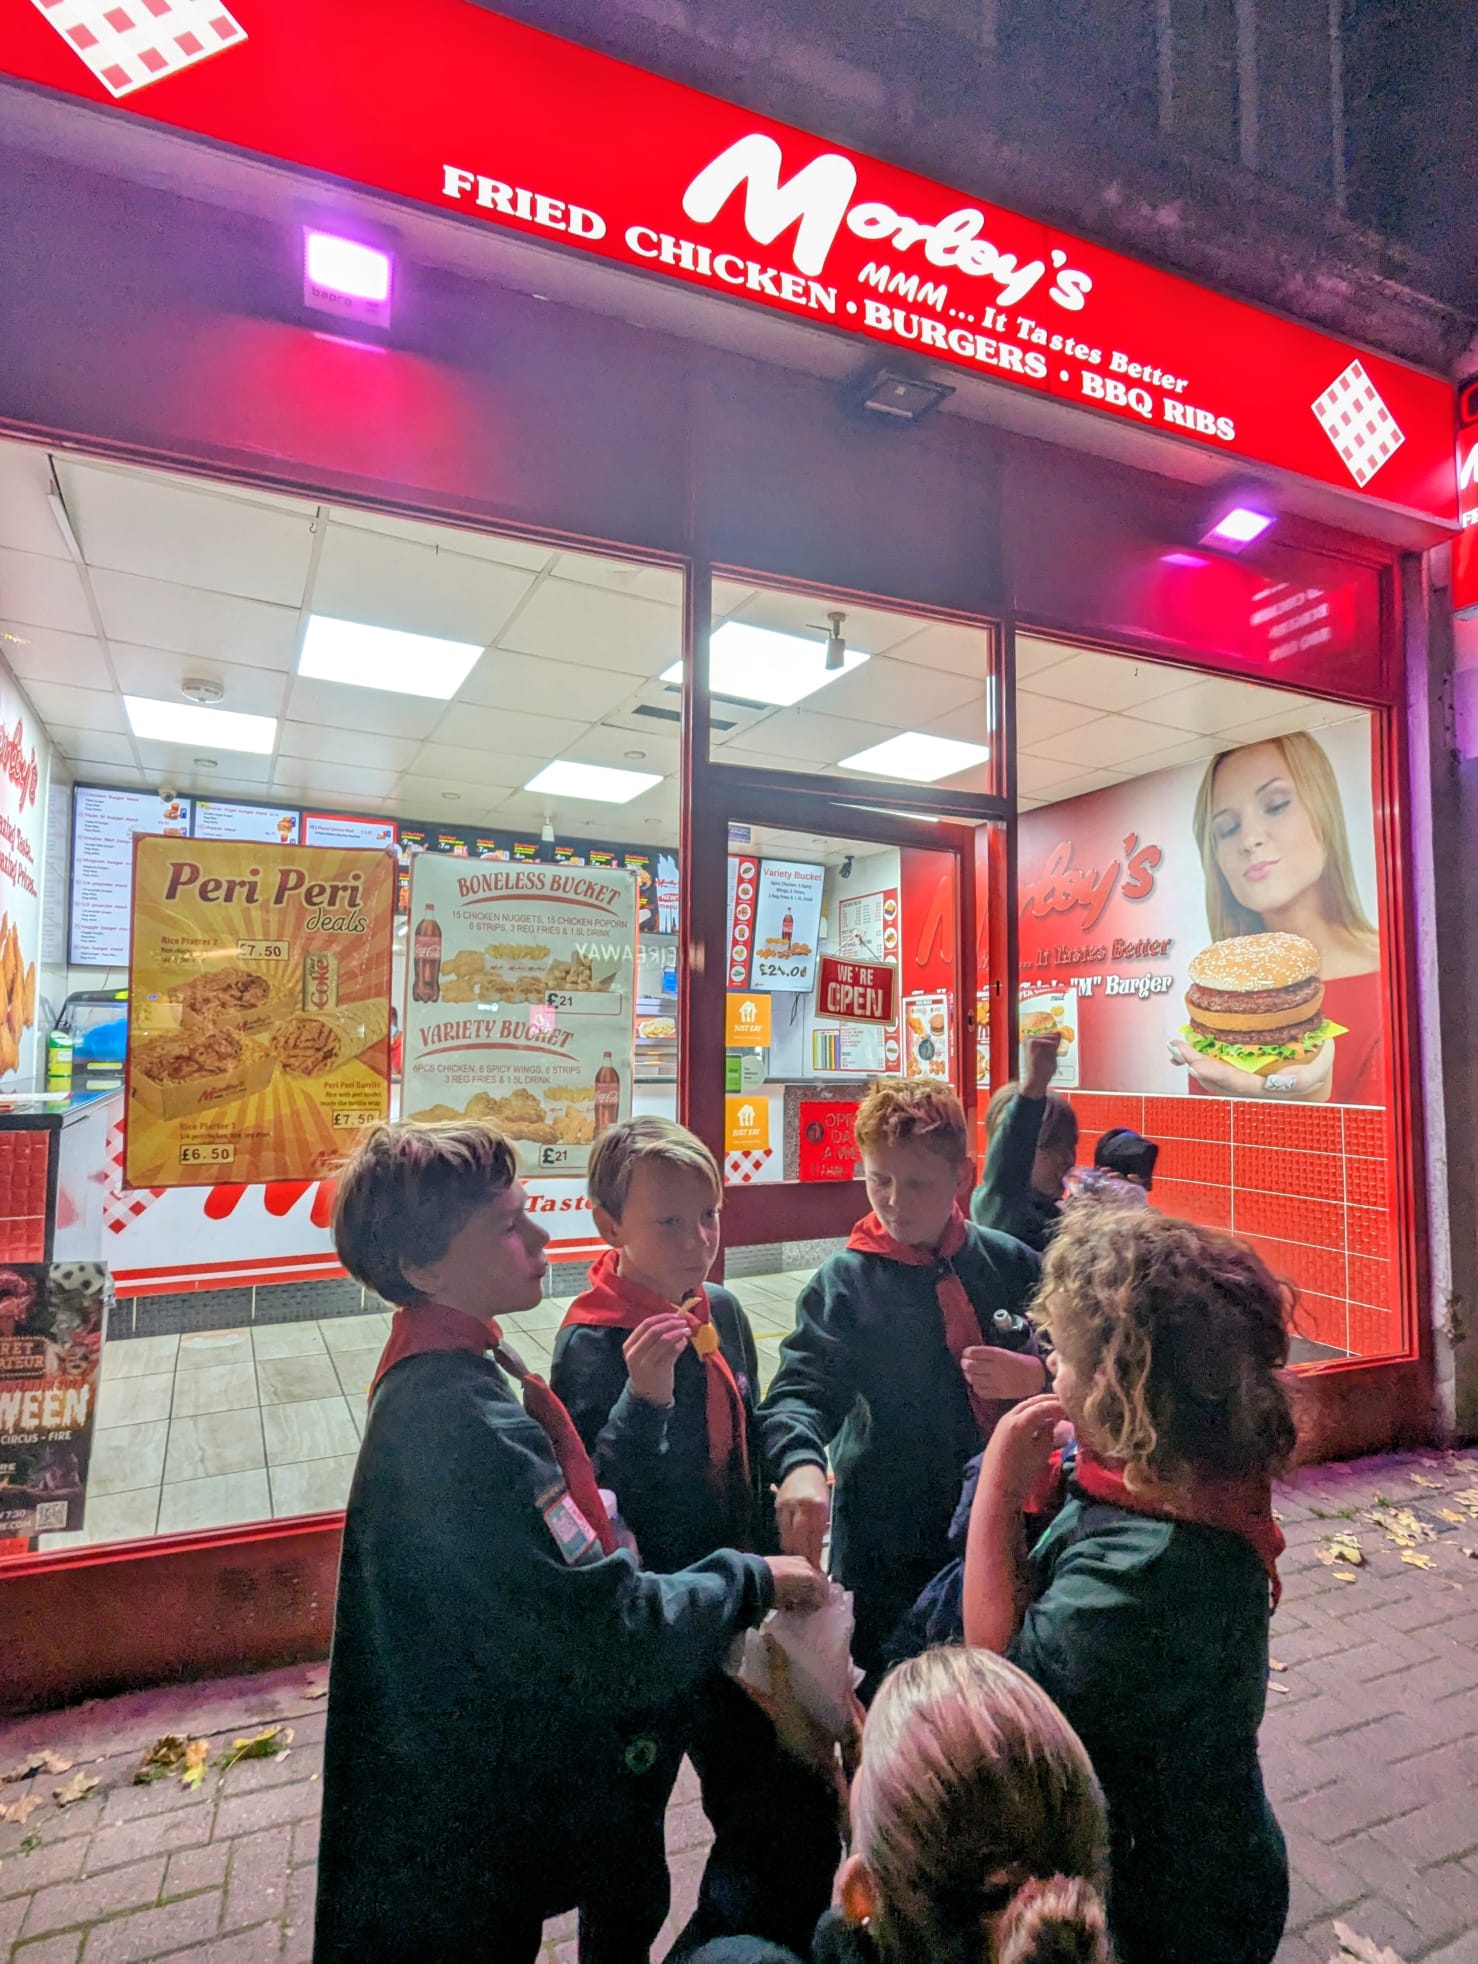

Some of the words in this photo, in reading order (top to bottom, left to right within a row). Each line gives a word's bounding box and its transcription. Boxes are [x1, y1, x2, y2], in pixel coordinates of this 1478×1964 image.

[683, 134, 1092, 310] Morley's
[443, 165, 607, 240] FRIED
[625, 226, 838, 314] CHICKEN
[864, 299, 1047, 379] BURGERS
[1082, 371, 1153, 419] BBQ
[1163, 398, 1236, 441] RIBS
[982, 307, 1008, 333] It
[1017, 317, 1103, 364] Tastes
[1109, 351, 1188, 394] Better
[165, 862, 260, 905] Peri
[273, 868, 361, 908] Peri
[763, 867, 793, 879] Variety
[794, 871, 823, 882] Bucket
[457, 872, 546, 898] BONELESS
[550, 874, 621, 906] BUCKET
[306, 907, 368, 932] deals
[452, 911, 461, 919] 15
[463, 912, 500, 921] CHICKEN
[547, 916, 556, 925] 15
[557, 918, 594, 928] CHICKEN
[517, 925, 536, 934] REG
[537, 926, 560, 936] FRIES
[562, 927, 568, 935] &
[587, 928, 611, 938] DRINK
[1111, 938, 1172, 961] Better
[311, 959, 329, 1008] Coke
[838, 963, 874, 986] WE'RE
[1105, 973, 1173, 999] Burger
[546, 992, 574, 1010] £21
[827, 981, 883, 1018] OPEN
[419, 1019, 497, 1047] VARIETY
[500, 1019, 575, 1048] BUCKET
[734, 1024, 748, 1033] JUST
[749, 1024, 762, 1033] EAT
[451, 1075, 470, 1084] REG
[472, 1075, 497, 1084] FRIES
[524, 1075, 550, 1084] DRINK
[486, 1065, 511, 1074] SPICY
[552, 1065, 582, 1074] STRIPS
[334, 1113, 374, 1126] £7.50
[732, 1128, 747, 1137] JUST
[748, 1128, 760, 1137] EAT
[182, 1148, 230, 1161] £6.50
[542, 1147, 568, 1164] £21
[0, 1384, 90, 1434] WEEN
[0, 1433, 38, 1445] CIRCUS
[48, 1431, 72, 1442] FIRE
